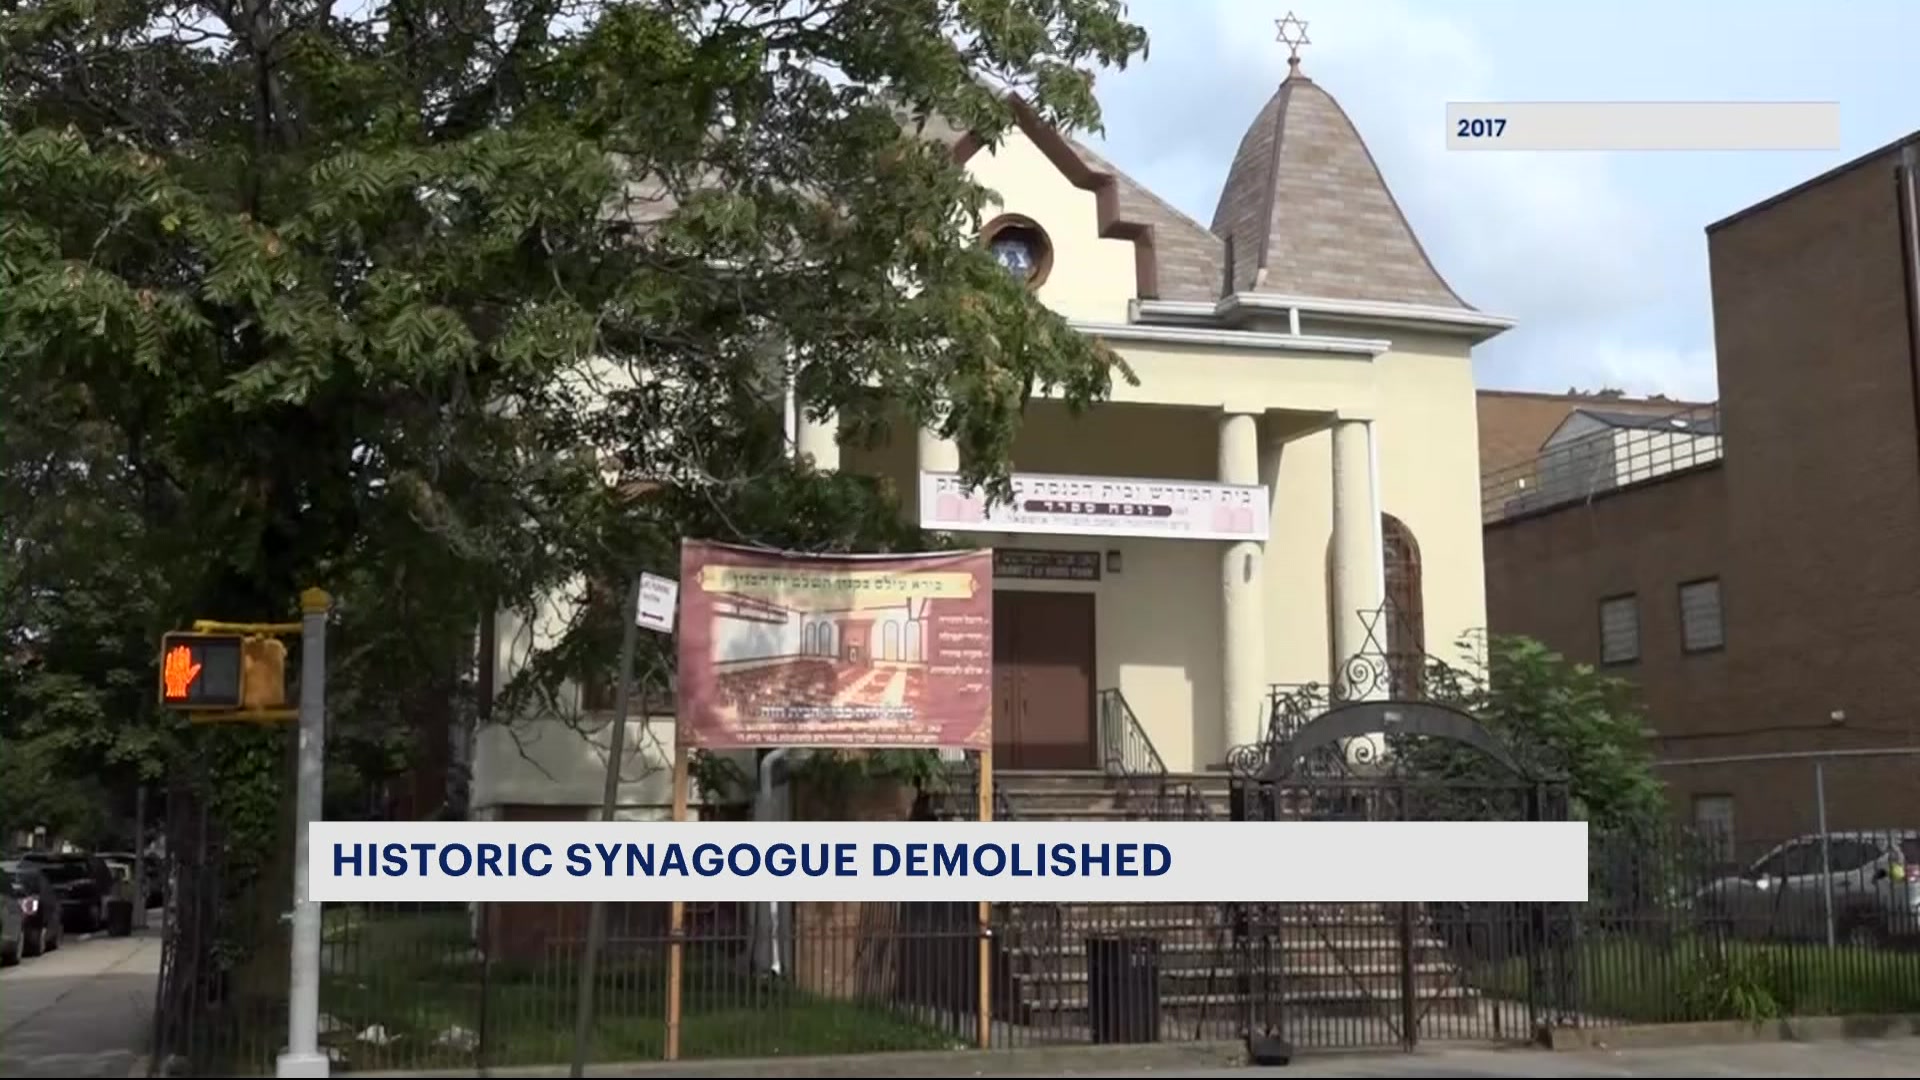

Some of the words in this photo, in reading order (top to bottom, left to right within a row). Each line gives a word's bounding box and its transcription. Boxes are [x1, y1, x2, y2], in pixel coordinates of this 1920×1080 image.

[1149, 487, 1212, 502] המדרש
[1221, 490, 1251, 504] בית
[1044, 501, 1097, 514] ספרד
[1108, 504, 1154, 517] נוסח
